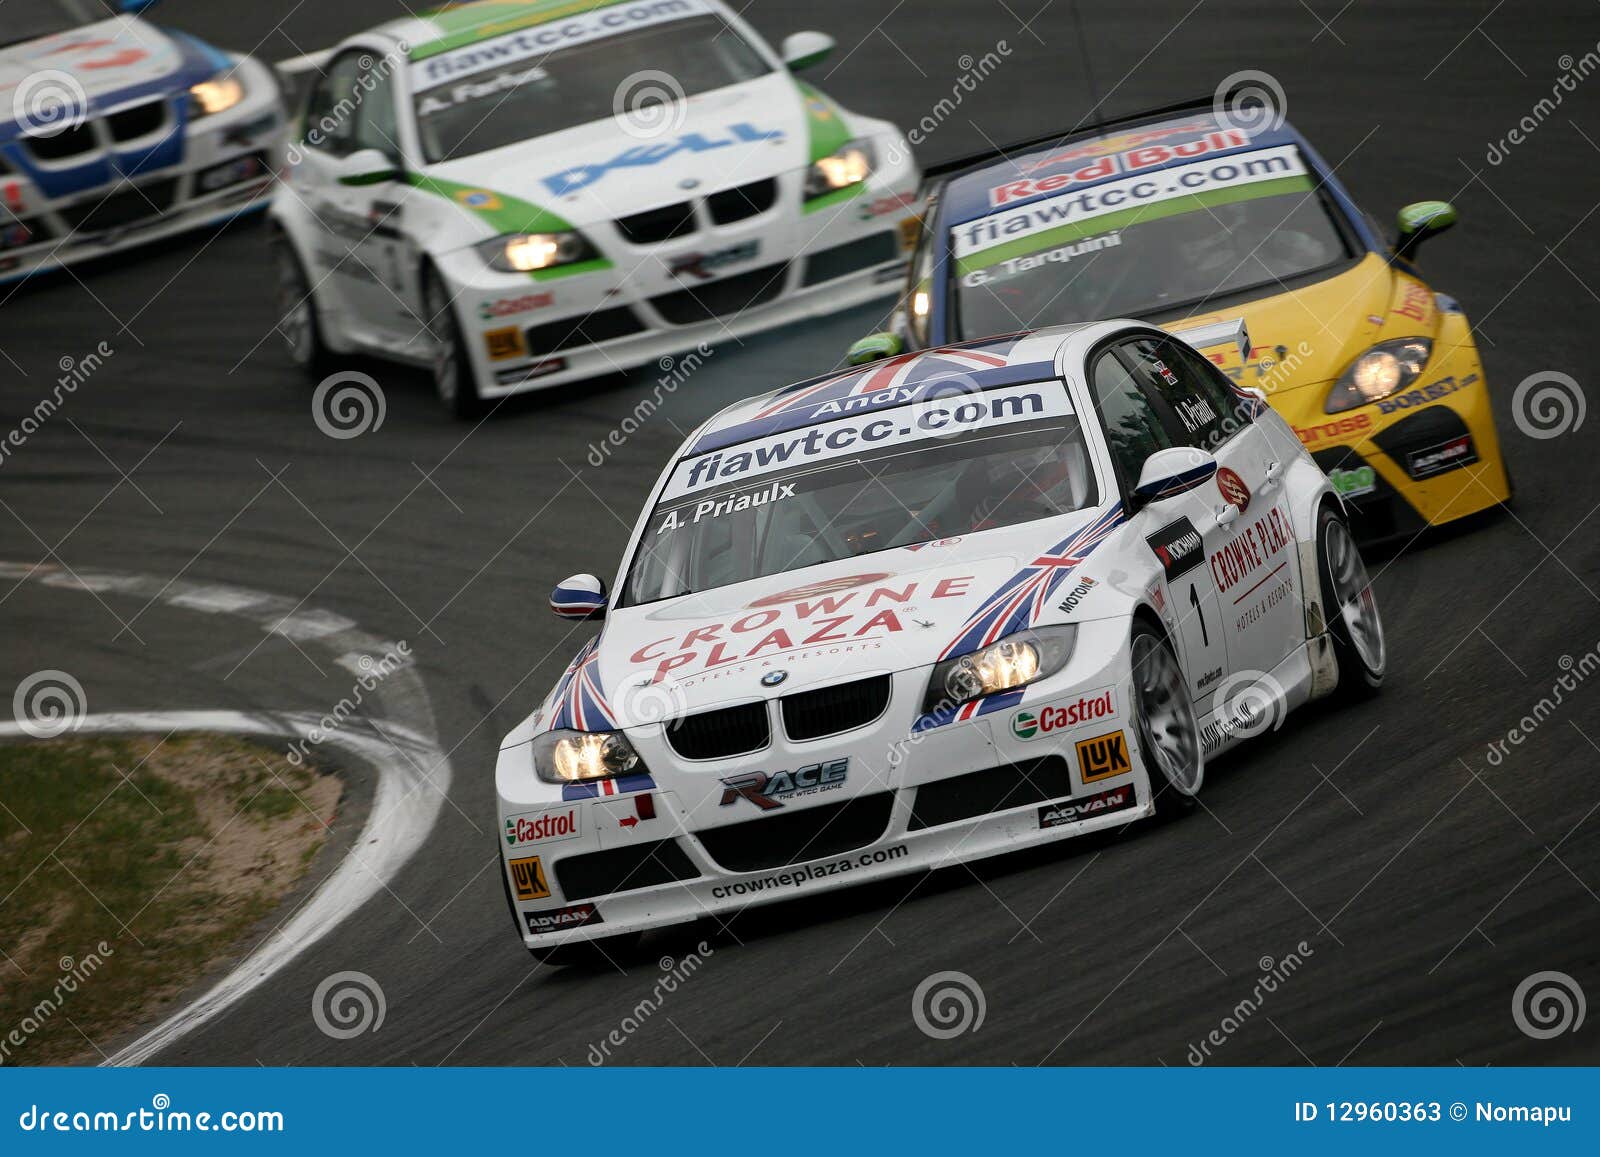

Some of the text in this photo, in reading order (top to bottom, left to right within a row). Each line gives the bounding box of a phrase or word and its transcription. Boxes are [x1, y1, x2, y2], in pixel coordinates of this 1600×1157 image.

[425, 0, 692, 80] fiawtcc.com
[539, 123, 785, 197] DELL
[993, 130, 1247, 205] Red Bull
[966, 152, 1291, 247] fiawtcc.com
[962, 230, 1122, 289] G. Tarquini
[809, 385, 925, 418] Andy
[686, 391, 1044, 488] fiawtcc.com
[656, 480, 796, 535] A. Priaulx
[1210, 506, 1297, 594] CROWNE PLAZA
[629, 575, 975, 664] CROWNE
[1190, 582, 1209, 648] 1
[651, 608, 904, 685] PLAZA
[787, 642, 882, 663] RESORTS
[1040, 690, 1114, 733] Castrol
[718, 757, 850, 811] RACE
[778, 782, 845, 801] THE WTCC GAME
[1043, 794, 1124, 822] ADVAN
[516, 810, 577, 843] Castrol
[711, 843, 910, 899] crowneplaza.com
[529, 911, 590, 929] ADVAN
